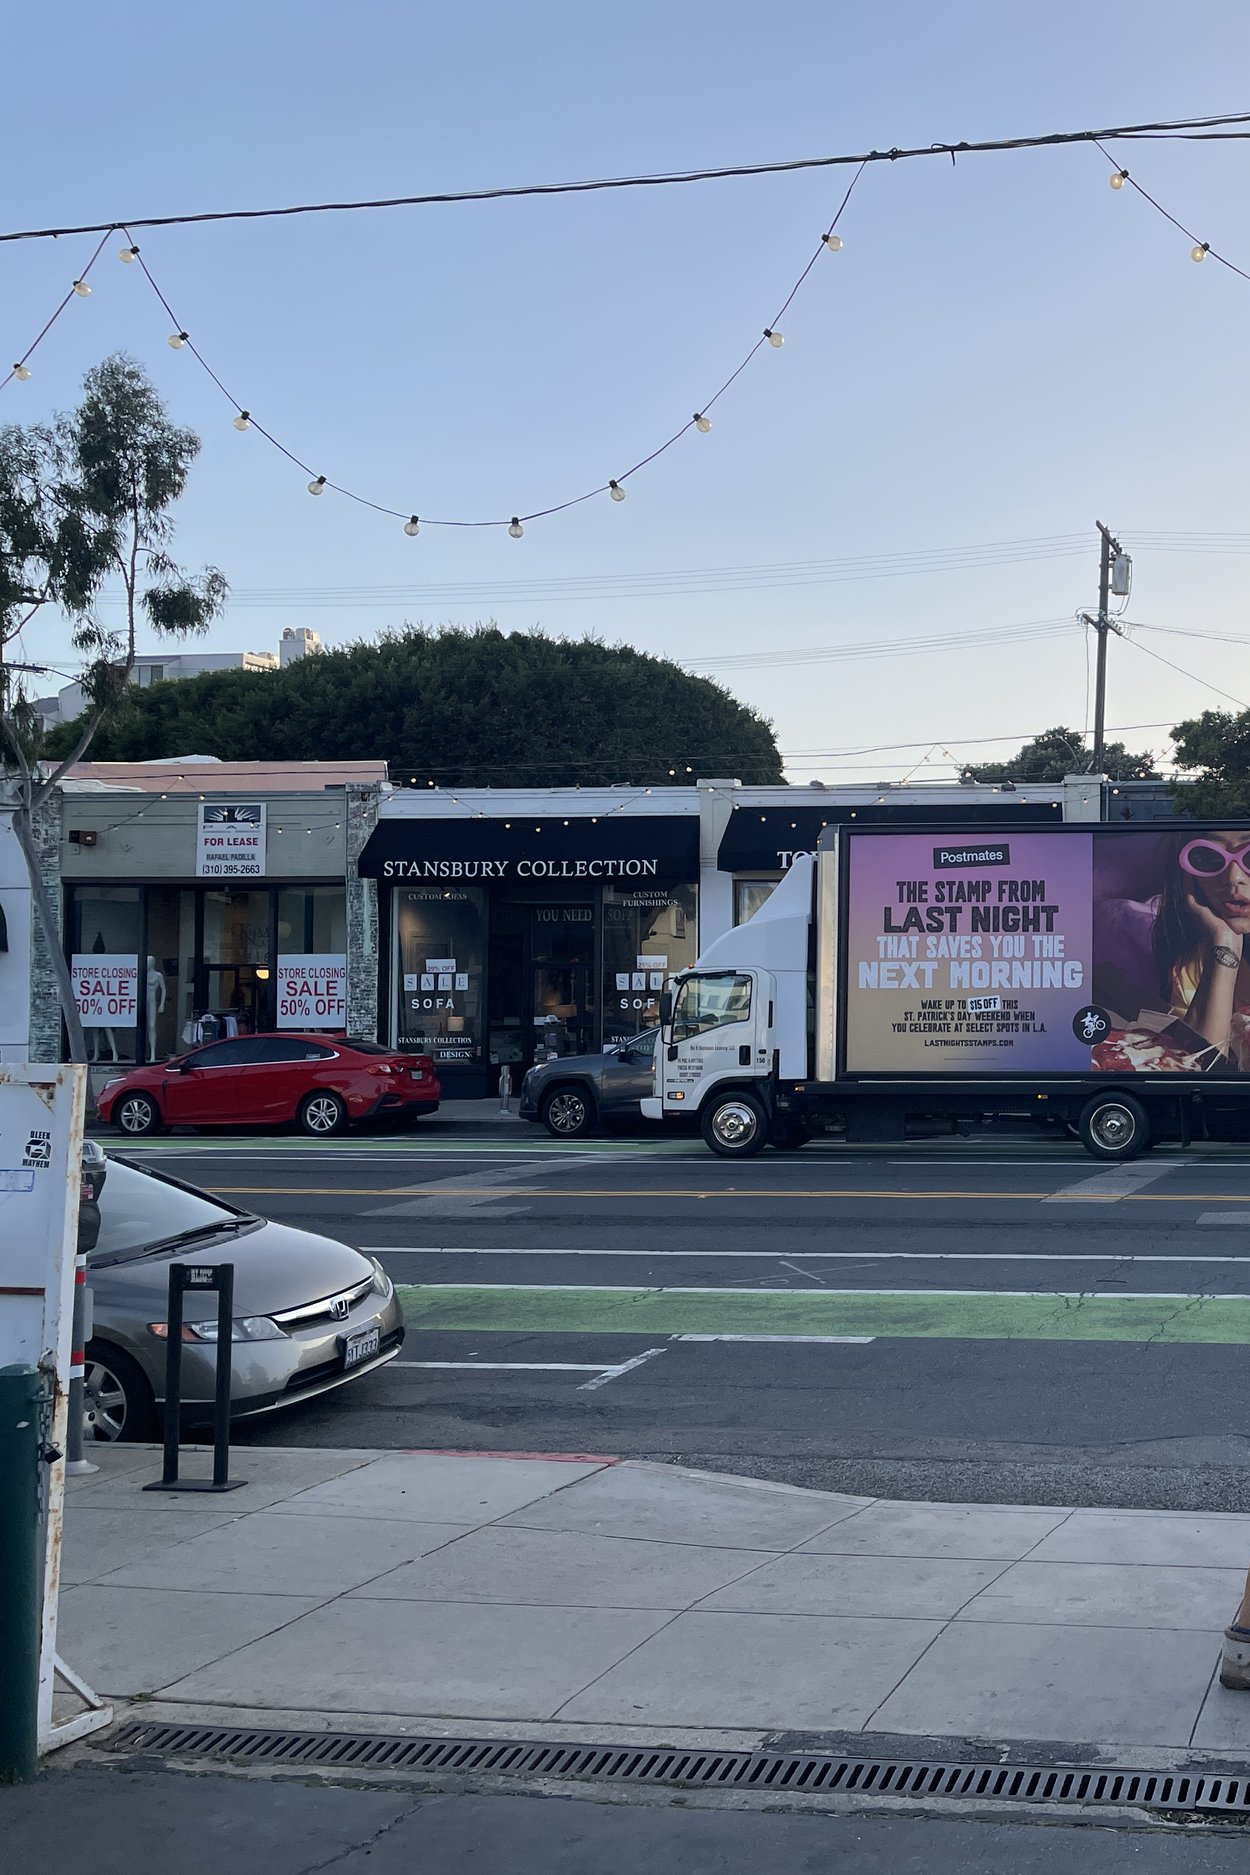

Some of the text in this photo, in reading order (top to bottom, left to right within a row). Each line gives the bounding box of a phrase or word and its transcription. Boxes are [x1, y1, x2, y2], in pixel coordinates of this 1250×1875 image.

[204, 837, 259, 846] FOR LEASE
[206, 853, 256, 861] RAFAEL PADILLA
[940, 849, 1004, 864] Postmates
[202, 864, 260, 874] (310) 395-2663
[383, 859, 659, 877] STANSBURY COLLECTION
[632, 890, 668, 899] CUSTOM
[896, 880, 1046, 903] THE STAMP FROM
[622, 898, 679, 907] FURNISHINGS
[536, 909, 559, 922] YOU
[563, 909, 592, 922] NEED
[883, 905, 1059, 933] LAST NIGHT
[876, 934, 1065, 959] THAT SAVES YOU THE
[72, 967, 137, 979] STORE CLOSING
[278, 967, 346, 979] STORE CLOSING
[858, 960, 1084, 989] NEXT MORNING
[406, 976, 466, 988] SALE
[618, 976, 661, 987] SAL
[79, 980, 130, 996] SALE
[286, 980, 338, 997] SALE
[75, 998, 137, 1015] 50% OFF
[280, 998, 345, 1016] 50% OFF
[411, 998, 455, 1009] SOFA
[619, 998, 656, 1009] SOF
[920, 997, 1018, 1011] WAKE UP TO $15 OFF THIS
[904, 1011, 1036, 1021] ST. PATRICK'S DAY WEEKEND WHEN
[891, 1023, 1047, 1033] YOU CELEBRATE AT SELECT SPOTS IN L.A.
[397, 1036, 472, 1044] STANSBURY COLLECTION
[21, 1158, 50, 1168] MAYHEM
